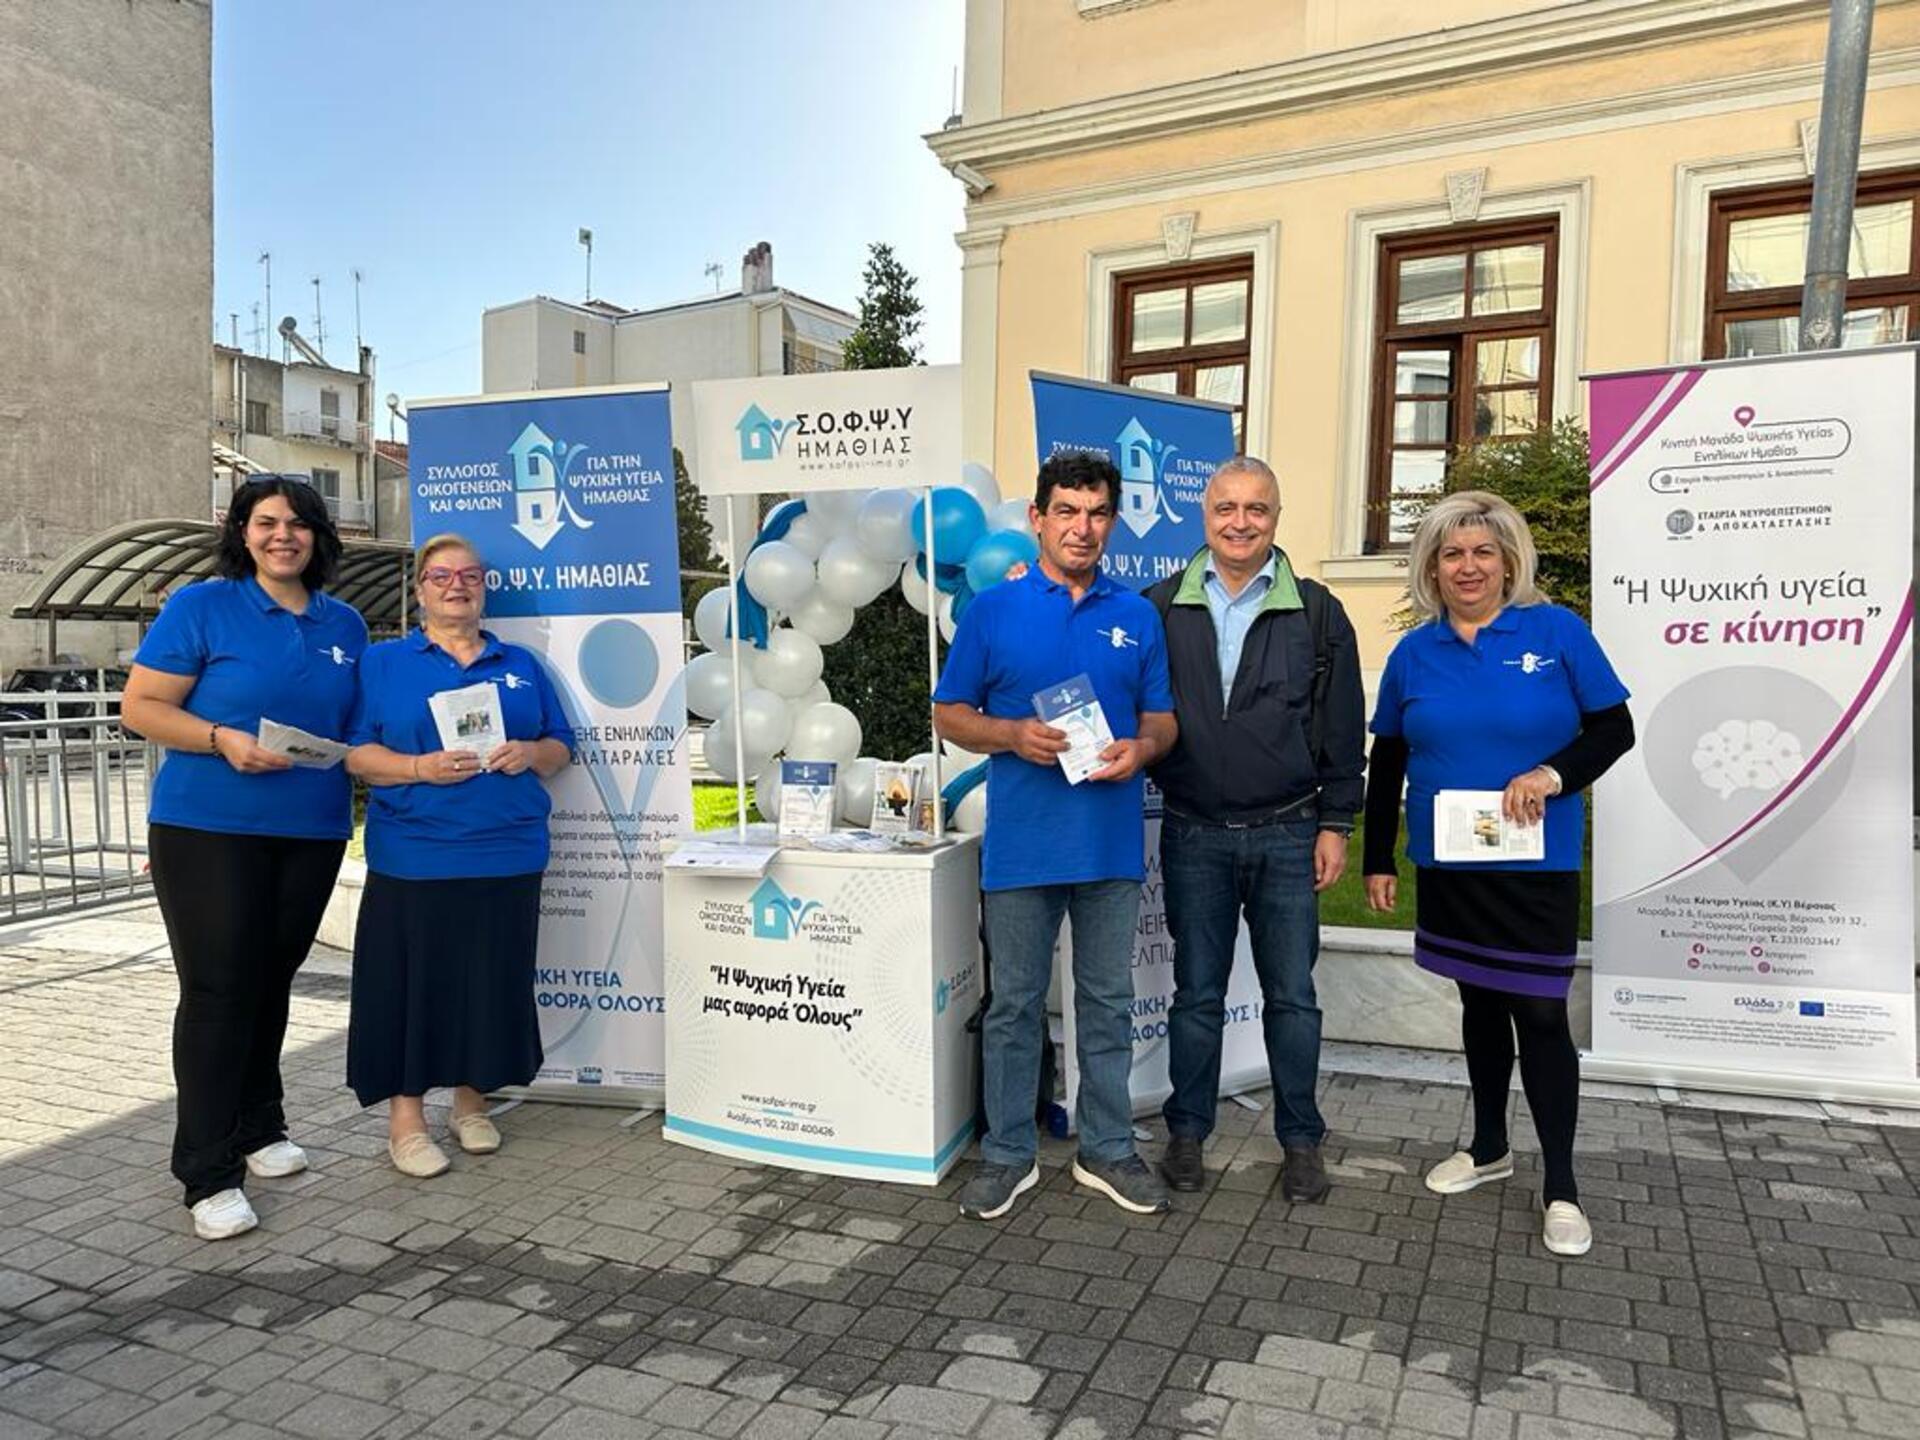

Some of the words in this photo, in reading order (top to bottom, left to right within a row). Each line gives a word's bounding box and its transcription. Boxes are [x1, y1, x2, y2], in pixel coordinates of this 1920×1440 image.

[796, 407, 912, 435] Σ.Ο.Φ.Ψ.Υ
[1661, 437, 1697, 449] Κινητή
[1700, 432, 1744, 446] Μονάδα
[1747, 429, 1794, 443] Ψυχικής
[1797, 427, 1834, 440] Υγείας
[798, 436, 911, 458] ΗΜΑΘΙΑΣ
[1694, 451, 1748, 462] Ενηλίκων
[1751, 445, 1798, 459] Ημαθίας
[587, 455, 608, 470] ΓΙΑ
[612, 454, 641, 468] ΤΗΝ
[1177, 458, 1193, 472] ΓΙΑ
[1194, 460, 1217, 474] ΤΗΝ
[427, 462, 499, 480] ΣΥΛΛΟΓΟΣ
[569, 473, 622, 488] ΨΥΧΙΚΗ
[625, 470, 663, 485] ΥΓΕΙΑ
[418, 479, 512, 497] ΟΙΚΟΓΕΝΕΙΩΝ
[1164, 473, 1203, 488] ΨΥΧΙΚΗ
[430, 499, 452, 512] ΚΑΙ
[454, 496, 503, 512] ΦΙΛΩΝ
[583, 487, 650, 505] ΗΜΑΘΙΑΣ
[1698, 510, 1736, 521] ΕΤΑΙΡΙΑ
[1740, 505, 1832, 518] ΝΕΥΡΟΕΠΙΣΤΗΜΩΝ
[1697, 524, 1705, 532] &
[1713, 517, 1832, 531] ΑΠΟΚΑΤΑΣΤΑΣΗΣ
[485, 566, 550, 591] Φ.Ψ.Υ.
[556, 563, 651, 589] ΗΜΑΘΙΑΣ
[1660, 574, 1768, 603] Ψυχική
[1780, 572, 1867, 605] υγεία
[1664, 621, 1709, 645] σε
[605, 725, 674, 741] ΕΝΗΛΙΚΩΝ
[571, 749, 675, 765] ΔΙΑΤΑΡΑΧΕΣ
[704, 900, 744, 914] ΣΥΛΛΟΓΟΣ
[699, 911, 752, 926] ΟΙΚΟΓΕΝΕΙΩΝ
[572, 970, 622, 987] ΥΓΕΙΑ
[732, 967, 792, 998] Ψυχική
[797, 974, 846, 1000] Υγεία
[598, 995, 666, 1012] ΟΛΟΥΣ
[703, 996, 731, 1017] μας
[733, 1001, 788, 1023] αφορά
